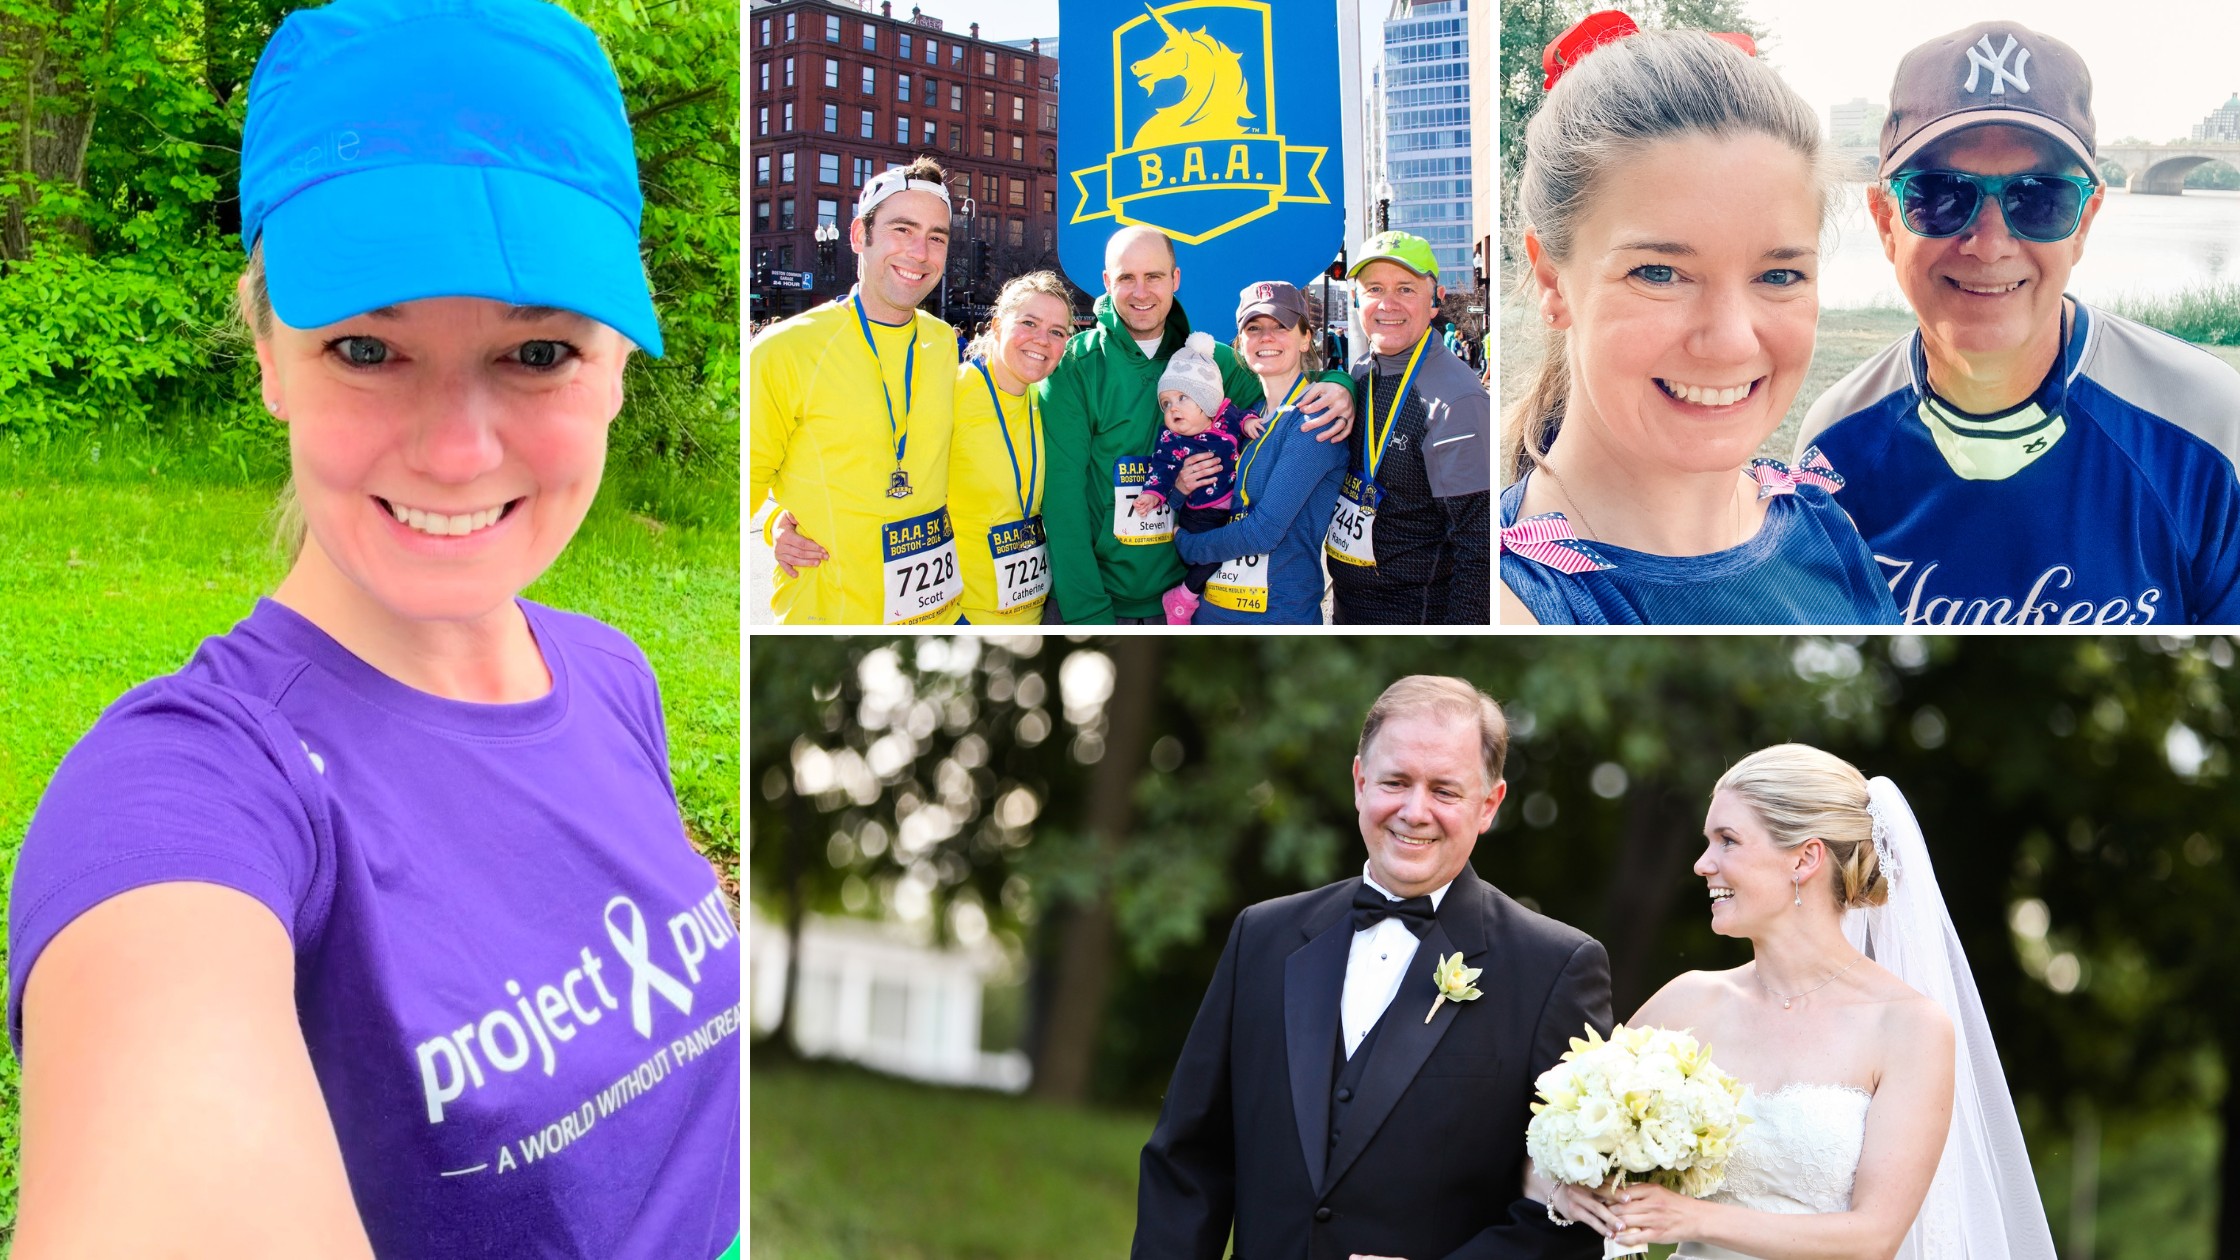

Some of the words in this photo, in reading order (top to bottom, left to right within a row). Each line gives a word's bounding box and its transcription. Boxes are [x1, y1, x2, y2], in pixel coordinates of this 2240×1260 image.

[1964, 33, 2032, 95] NY
[1138, 144, 1264, 189] B.A.A.
[1118, 462, 1147, 475] B.A.A.
[1121, 475, 1145, 483] BOSTON
[1351, 477, 1362, 492] 5K
[889, 525, 924, 545] B.A.A.
[926, 519, 941, 535] 5K
[1140, 521, 1165, 531] Steven
[1332, 532, 1350, 552] Randy
[896, 551, 954, 598] 7228
[1005, 552, 1048, 589] 7224
[918, 590, 944, 608] Scott
[1012, 582, 1045, 602] Catherine
[1873, 554, 2162, 625] Yankees
[1236, 598, 1260, 609] 7746
[909, 611, 935, 625] DISTANCE
[416, 946, 618, 1124] project
[498, 1145, 517, 1174] A
[518, 1101, 595, 1164] WORLD
[596, 1048, 671, 1119] WITHOUT
